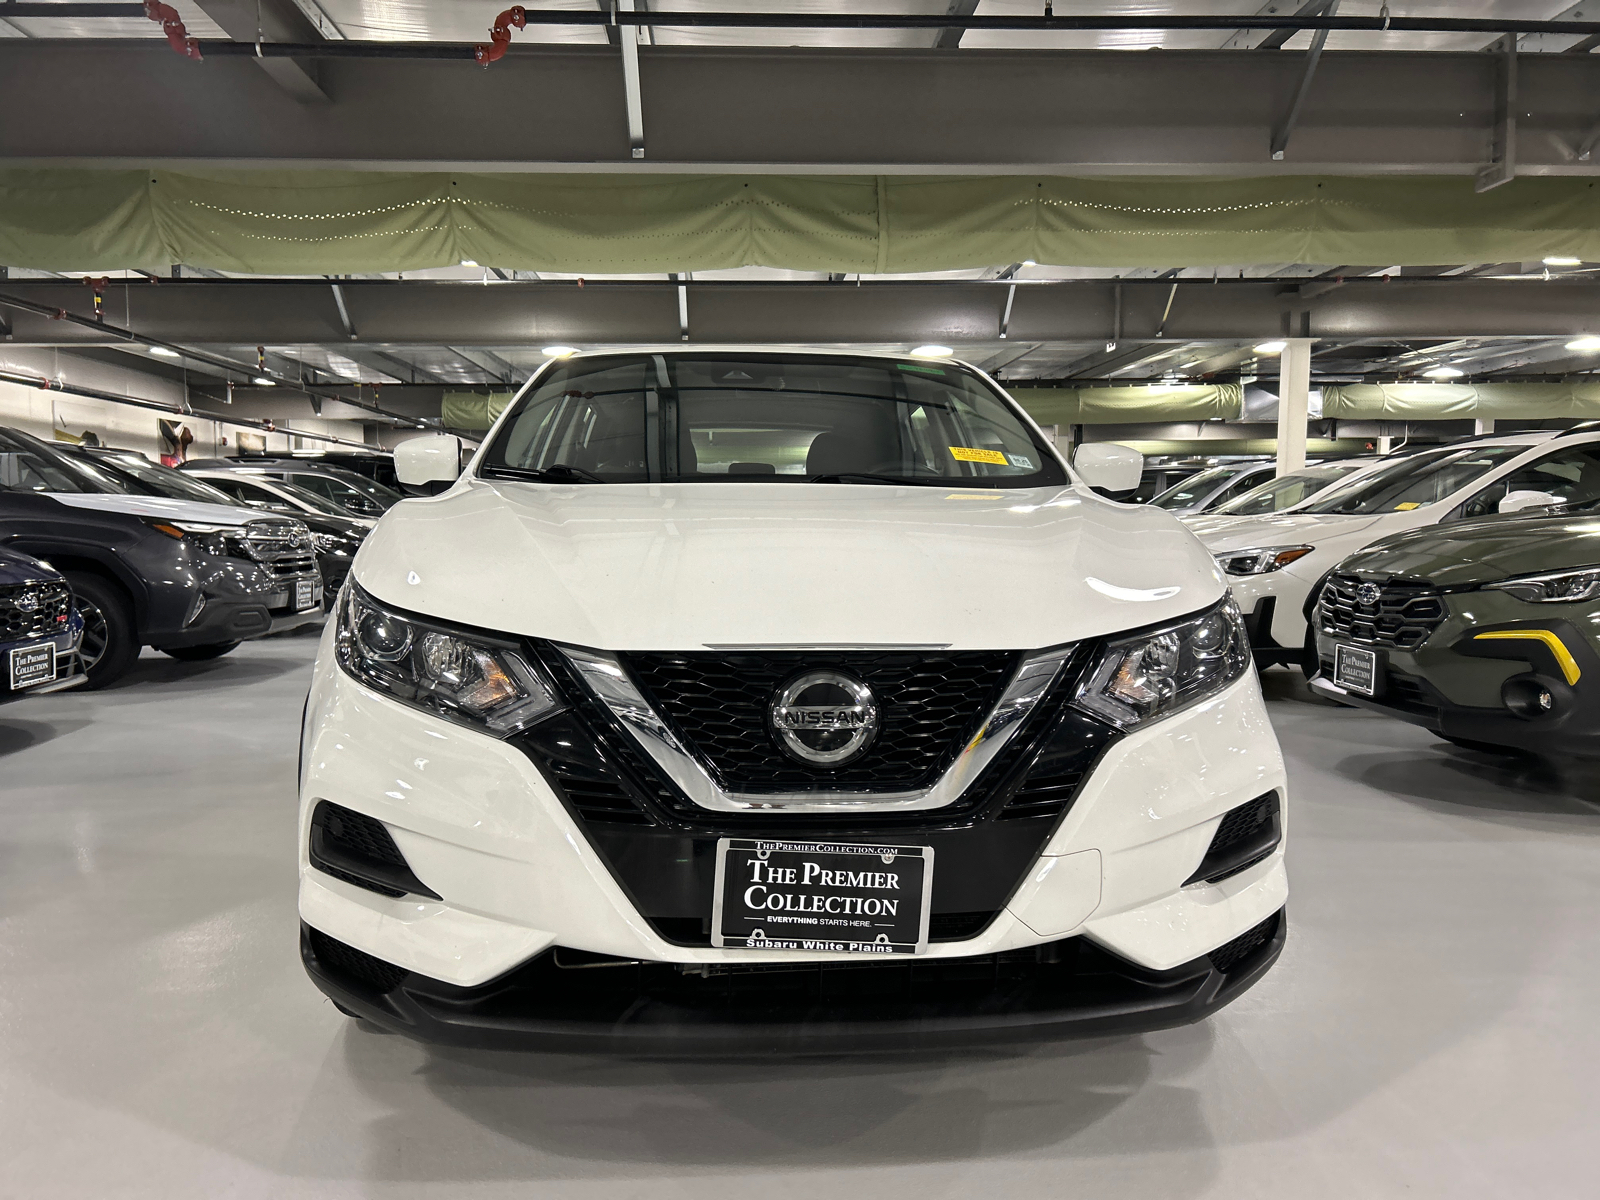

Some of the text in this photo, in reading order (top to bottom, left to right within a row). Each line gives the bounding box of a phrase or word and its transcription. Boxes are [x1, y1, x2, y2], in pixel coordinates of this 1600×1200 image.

[784, 711, 865, 724] NISSAN
[746, 859, 900, 890] THE PREMIER
[744, 885, 899, 916] COLLECTION
[767, 915, 872, 928] EVERYTHING STARTS HERE.
[746, 939, 893, 953] Subaru White Plains
